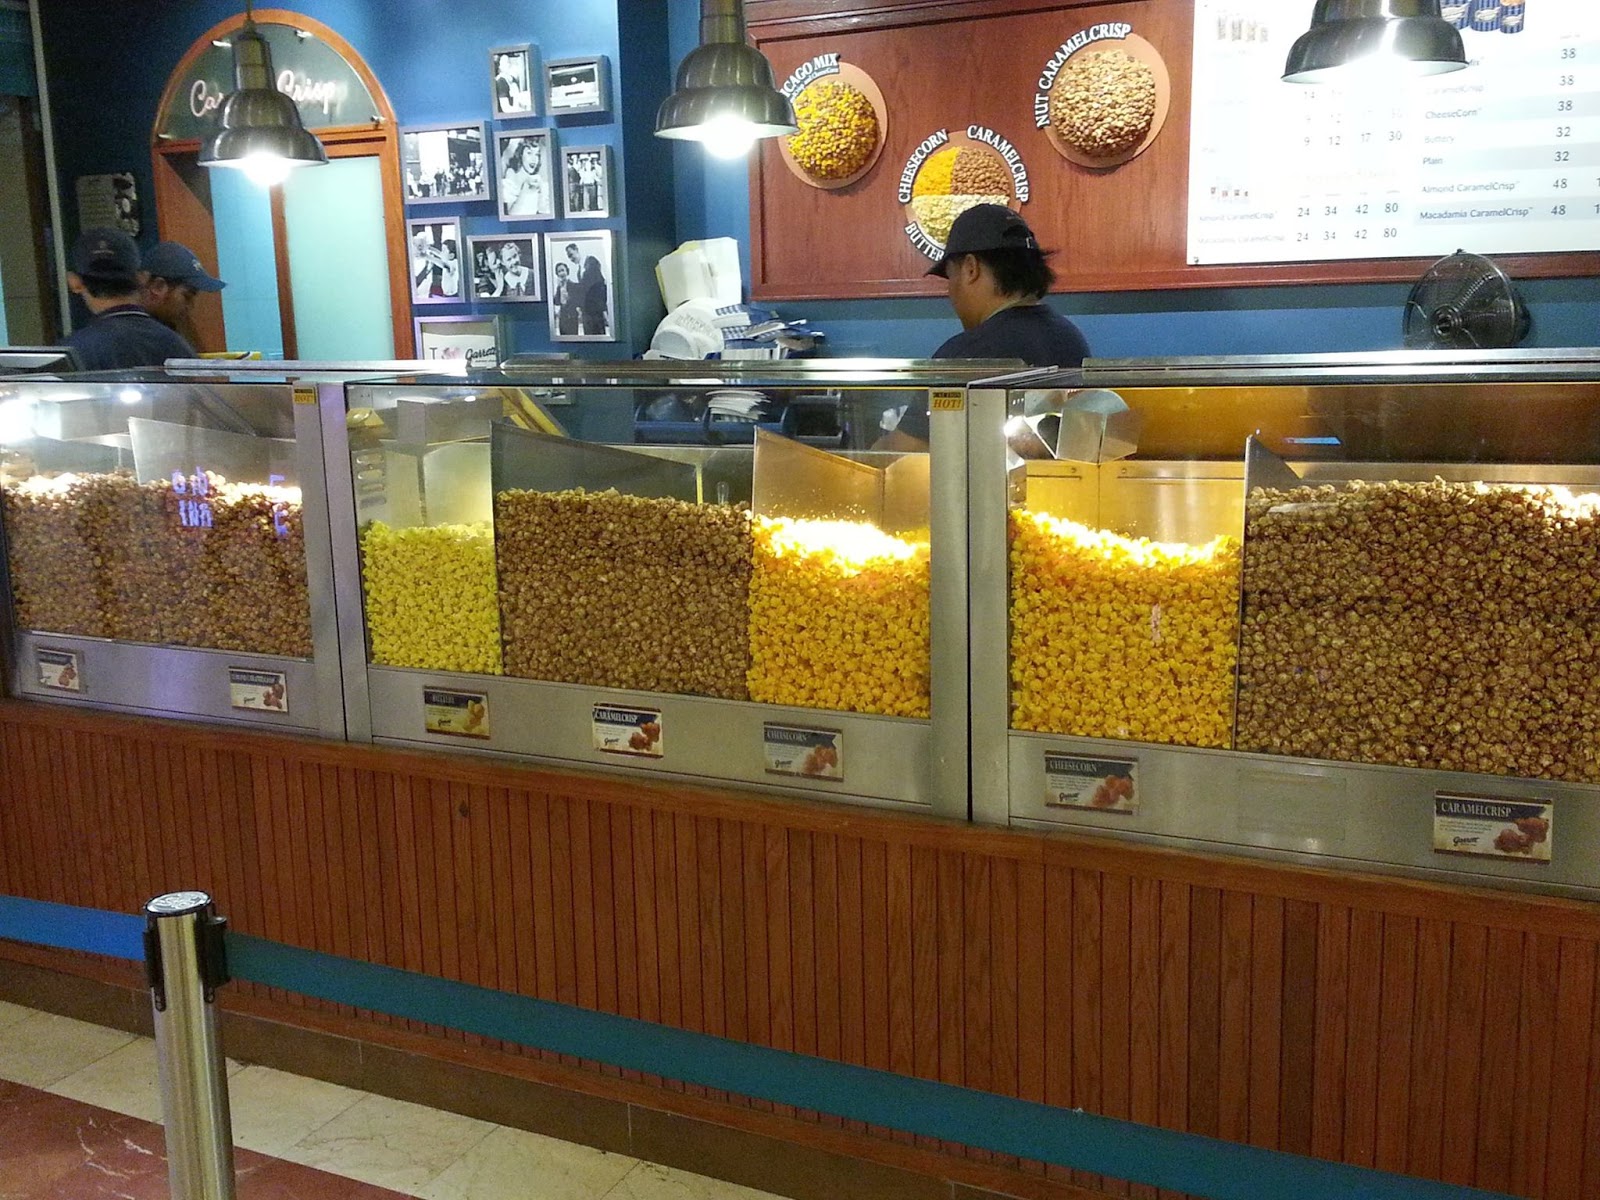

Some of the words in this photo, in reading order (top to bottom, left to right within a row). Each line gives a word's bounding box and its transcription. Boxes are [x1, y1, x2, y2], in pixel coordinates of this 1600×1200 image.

[1038, 22, 1132, 90] CARAMELCRISP
[1561, 48, 1577, 60] 38
[780, 62, 813, 98] ICAGO
[813, 52, 839, 71] MIX
[1559, 75, 1575, 86] 38
[1034, 93, 1050, 128] NUT
[1557, 100, 1573, 112] 38
[1388, 130, 1403, 142] 30
[1556, 126, 1572, 138] 32
[898, 128, 949, 203] CHEESECORN
[966, 124, 1030, 203] CARAMELCRISP
[1422, 156, 1443, 166] Plain
[1554, 151, 1570, 163] 32
[1552, 178, 1568, 190] 48
[1297, 207, 1311, 218] 24
[1324, 205, 1338, 216] 34
[1355, 203, 1369, 215] 42
[1384, 202, 1399, 213] 80
[1419, 209, 1468, 220] Macadamia
[1550, 204, 1567, 216] 48
[1296, 231, 1310, 242] 24
[1323, 230, 1337, 241] 34
[1354, 228, 1368, 240] 42
[1383, 227, 1398, 238] 80
[933, 398, 962, 409] HOT!
[1048, 760, 1098, 773] CHEESECORN
[1441, 802, 1512, 818] CARAMELCRISP
